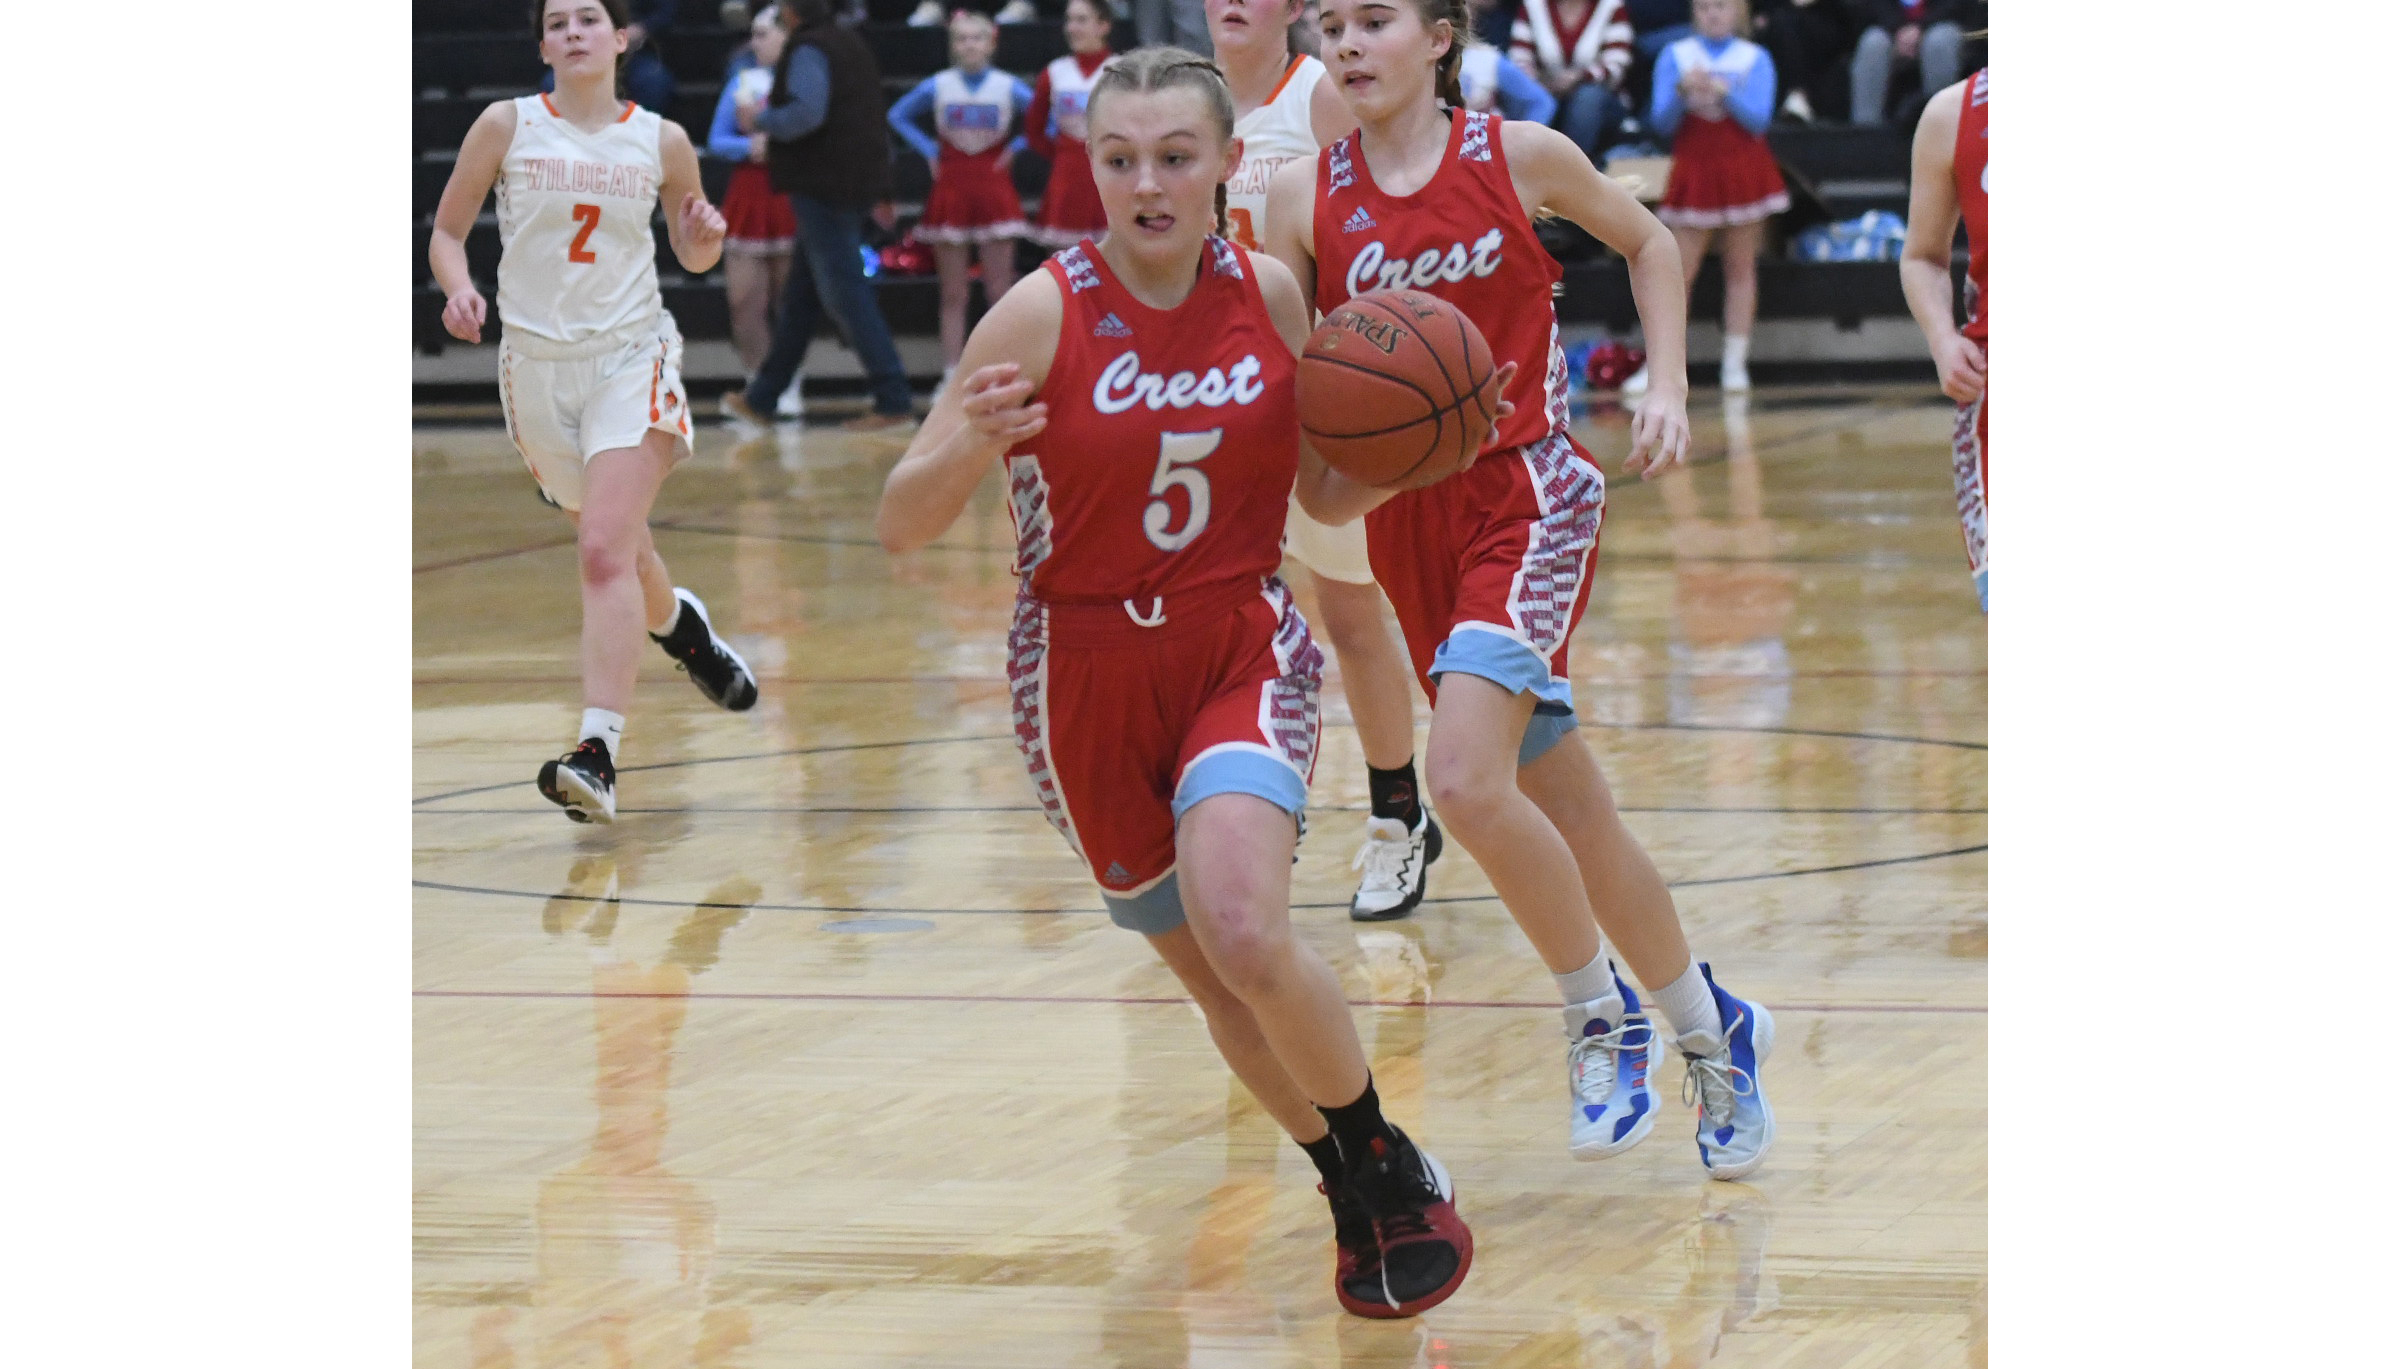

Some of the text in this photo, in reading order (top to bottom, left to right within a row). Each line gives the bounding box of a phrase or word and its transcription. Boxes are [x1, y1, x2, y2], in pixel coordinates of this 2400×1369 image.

[568, 203, 601, 264] 2
[1342, 219, 1377, 234] adidas
[1346, 227, 1504, 300] Crest
[1093, 350, 1265, 414] Crest
[1142, 427, 1224, 552] 5
